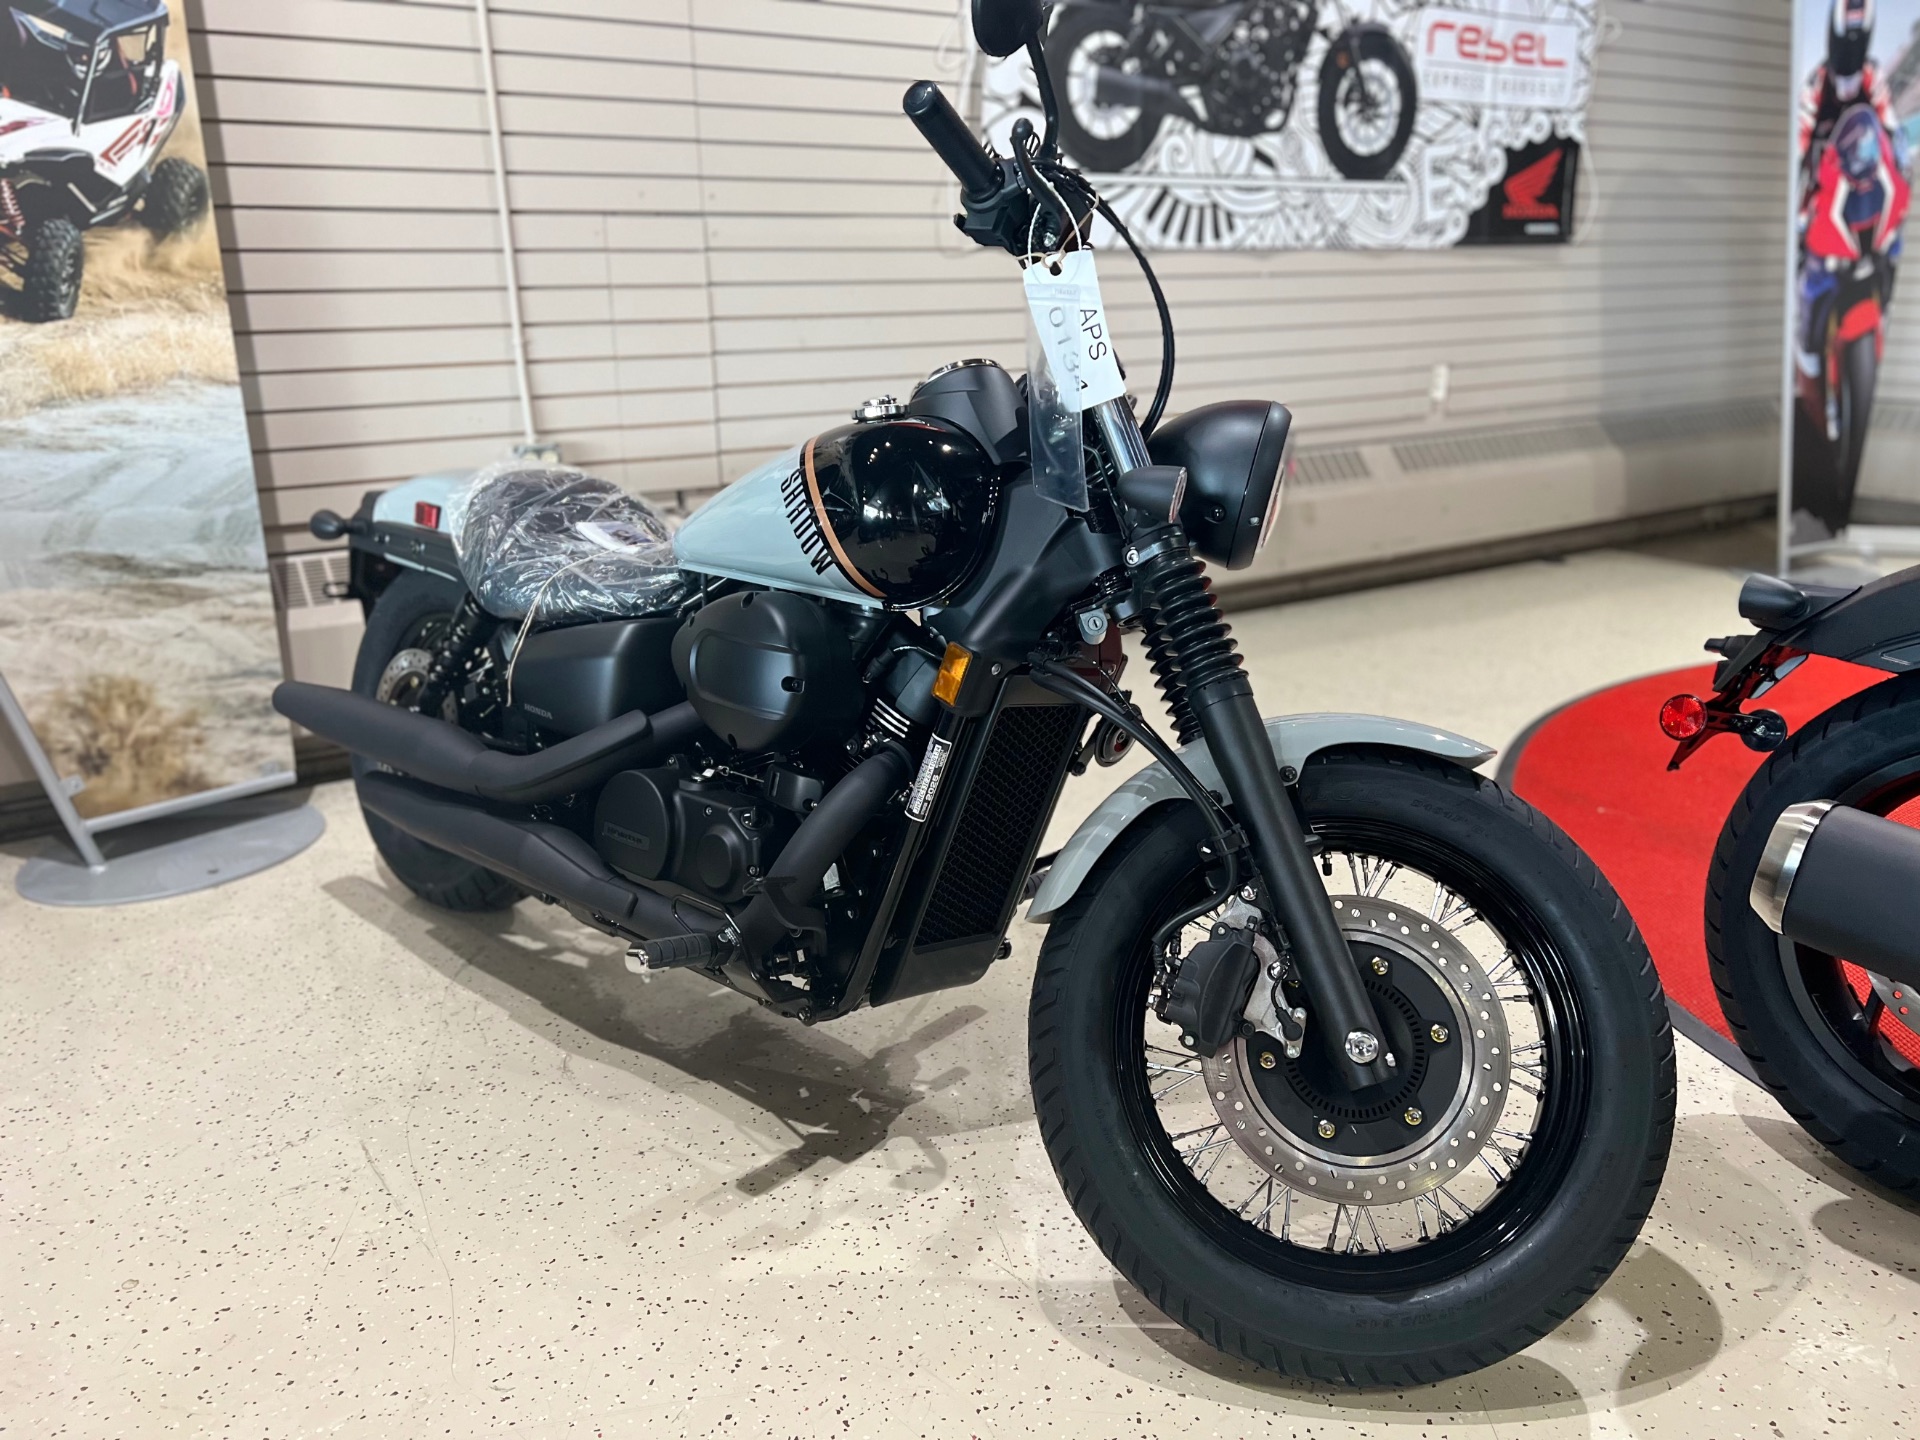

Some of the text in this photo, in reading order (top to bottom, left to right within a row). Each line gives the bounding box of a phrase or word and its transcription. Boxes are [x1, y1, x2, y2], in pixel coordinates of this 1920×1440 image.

[1079, 308, 1107, 361] APS
[780, 466, 835, 576] SHADOW
[524, 703, 553, 720] HONDA
